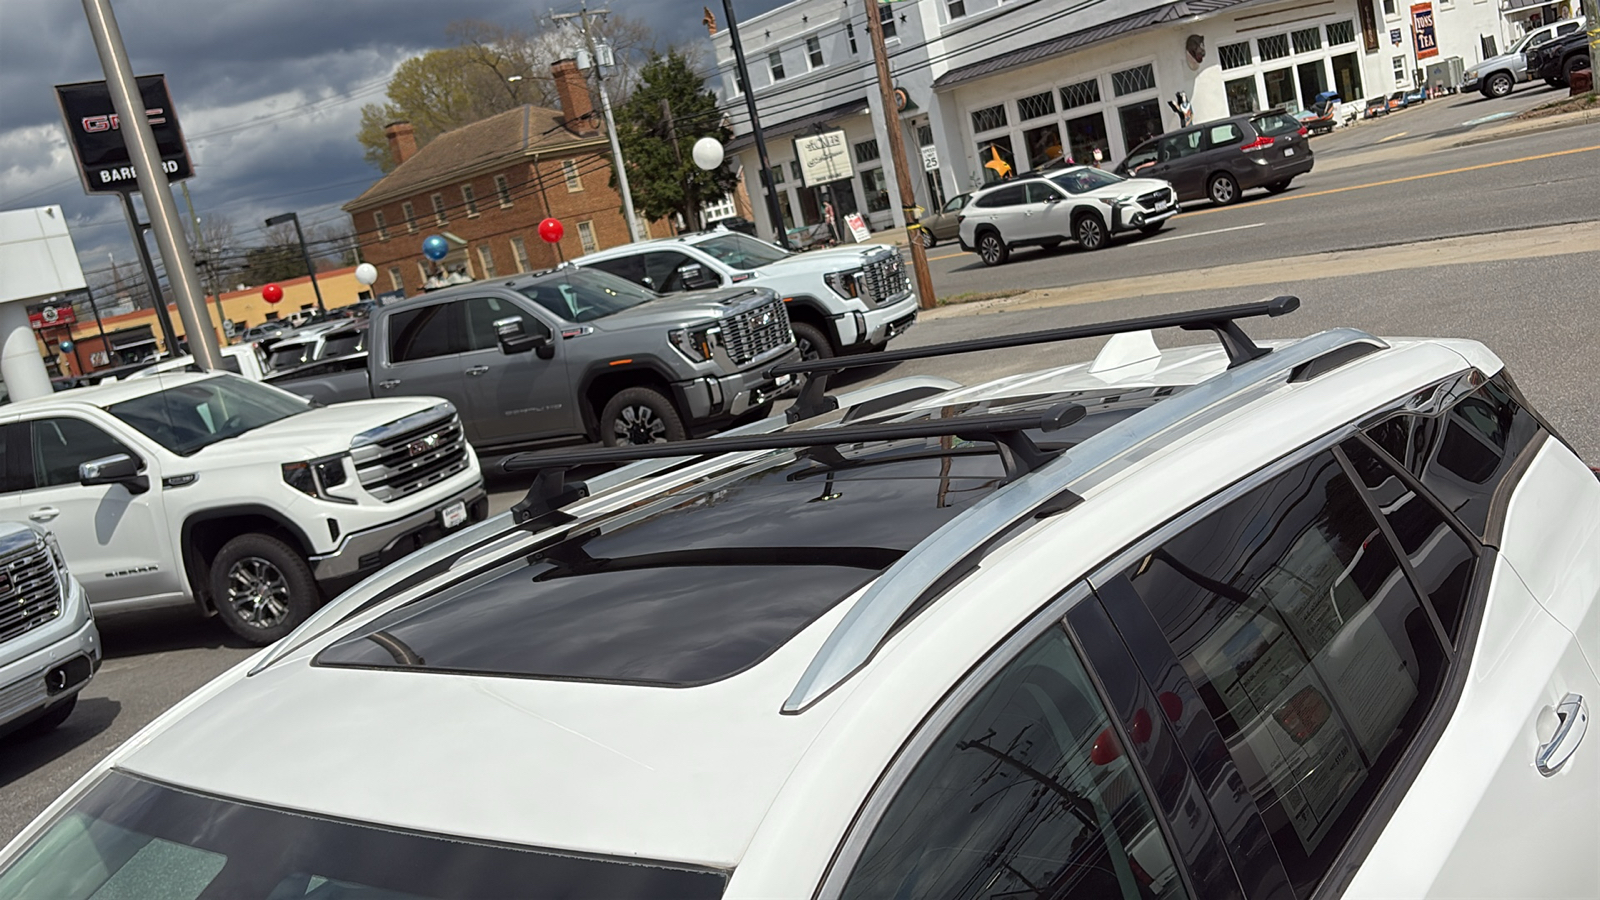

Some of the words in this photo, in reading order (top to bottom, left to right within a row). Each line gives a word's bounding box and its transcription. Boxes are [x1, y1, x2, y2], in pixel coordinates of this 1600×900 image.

[1418, 34, 1435, 48] TEA
[82, 107, 166, 133] GC
[925, 157, 938, 168] 25
